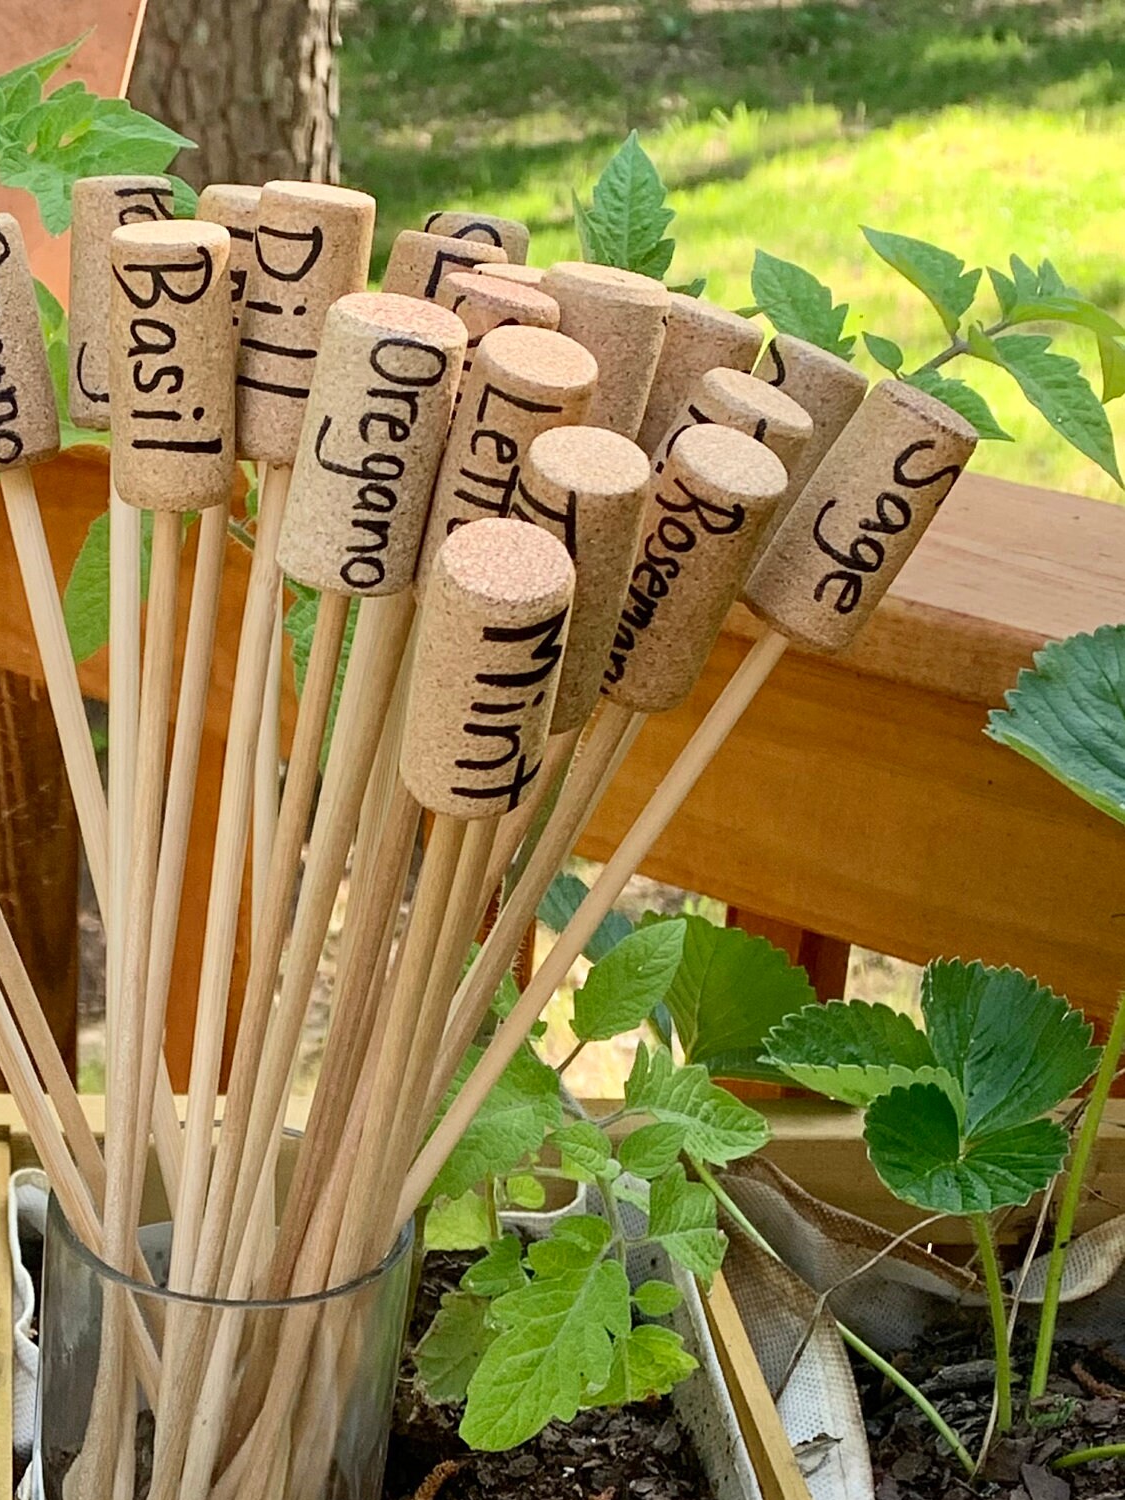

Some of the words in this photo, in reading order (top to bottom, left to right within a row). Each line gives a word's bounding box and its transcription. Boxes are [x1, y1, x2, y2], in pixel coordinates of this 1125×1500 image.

[111, 246, 223, 454] Basil
[235, 224, 322, 398] Dill
[317, 337, 447, 589] Oregano
[813, 439, 960, 614] Sage
[450, 604, 571, 813] Mint
